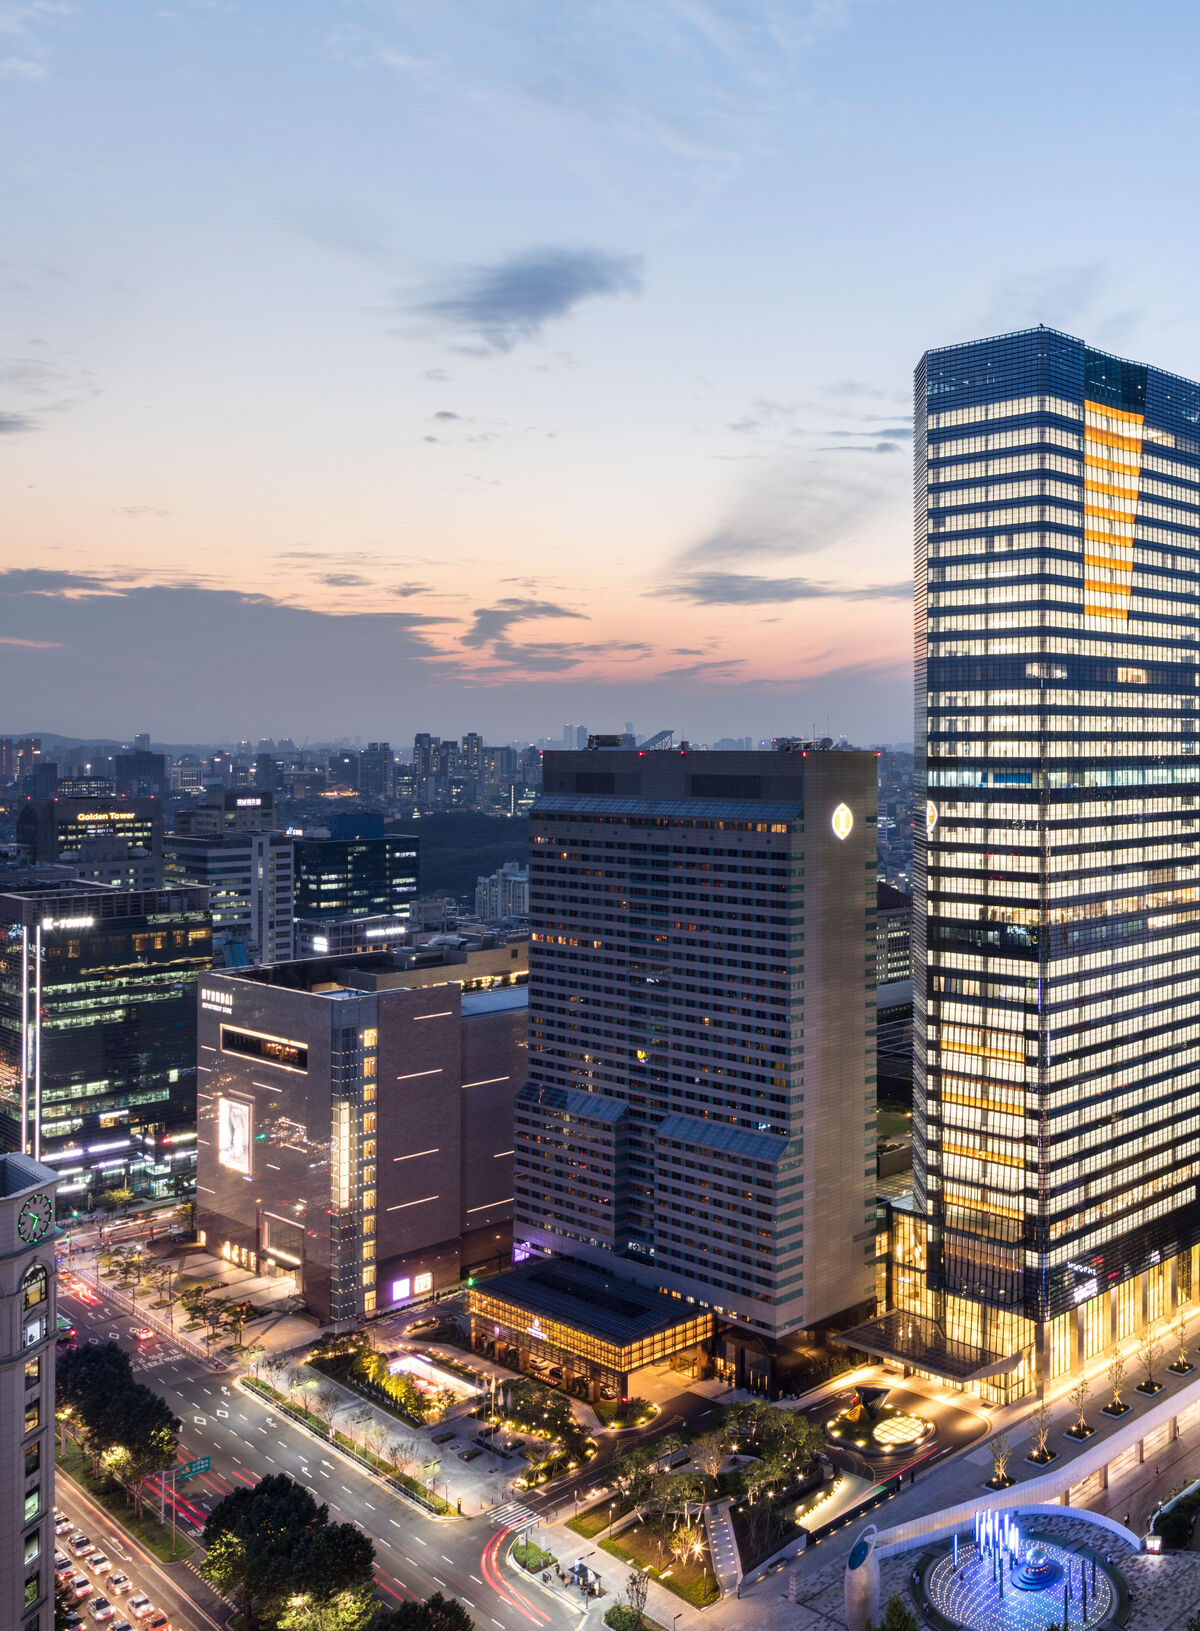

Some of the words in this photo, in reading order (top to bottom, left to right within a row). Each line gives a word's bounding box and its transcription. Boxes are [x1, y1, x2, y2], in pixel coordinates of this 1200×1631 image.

[77, 813, 109, 821] Golden
[109, 812, 136, 820] Tower
[201, 988, 233, 1006] HYUNDAI
